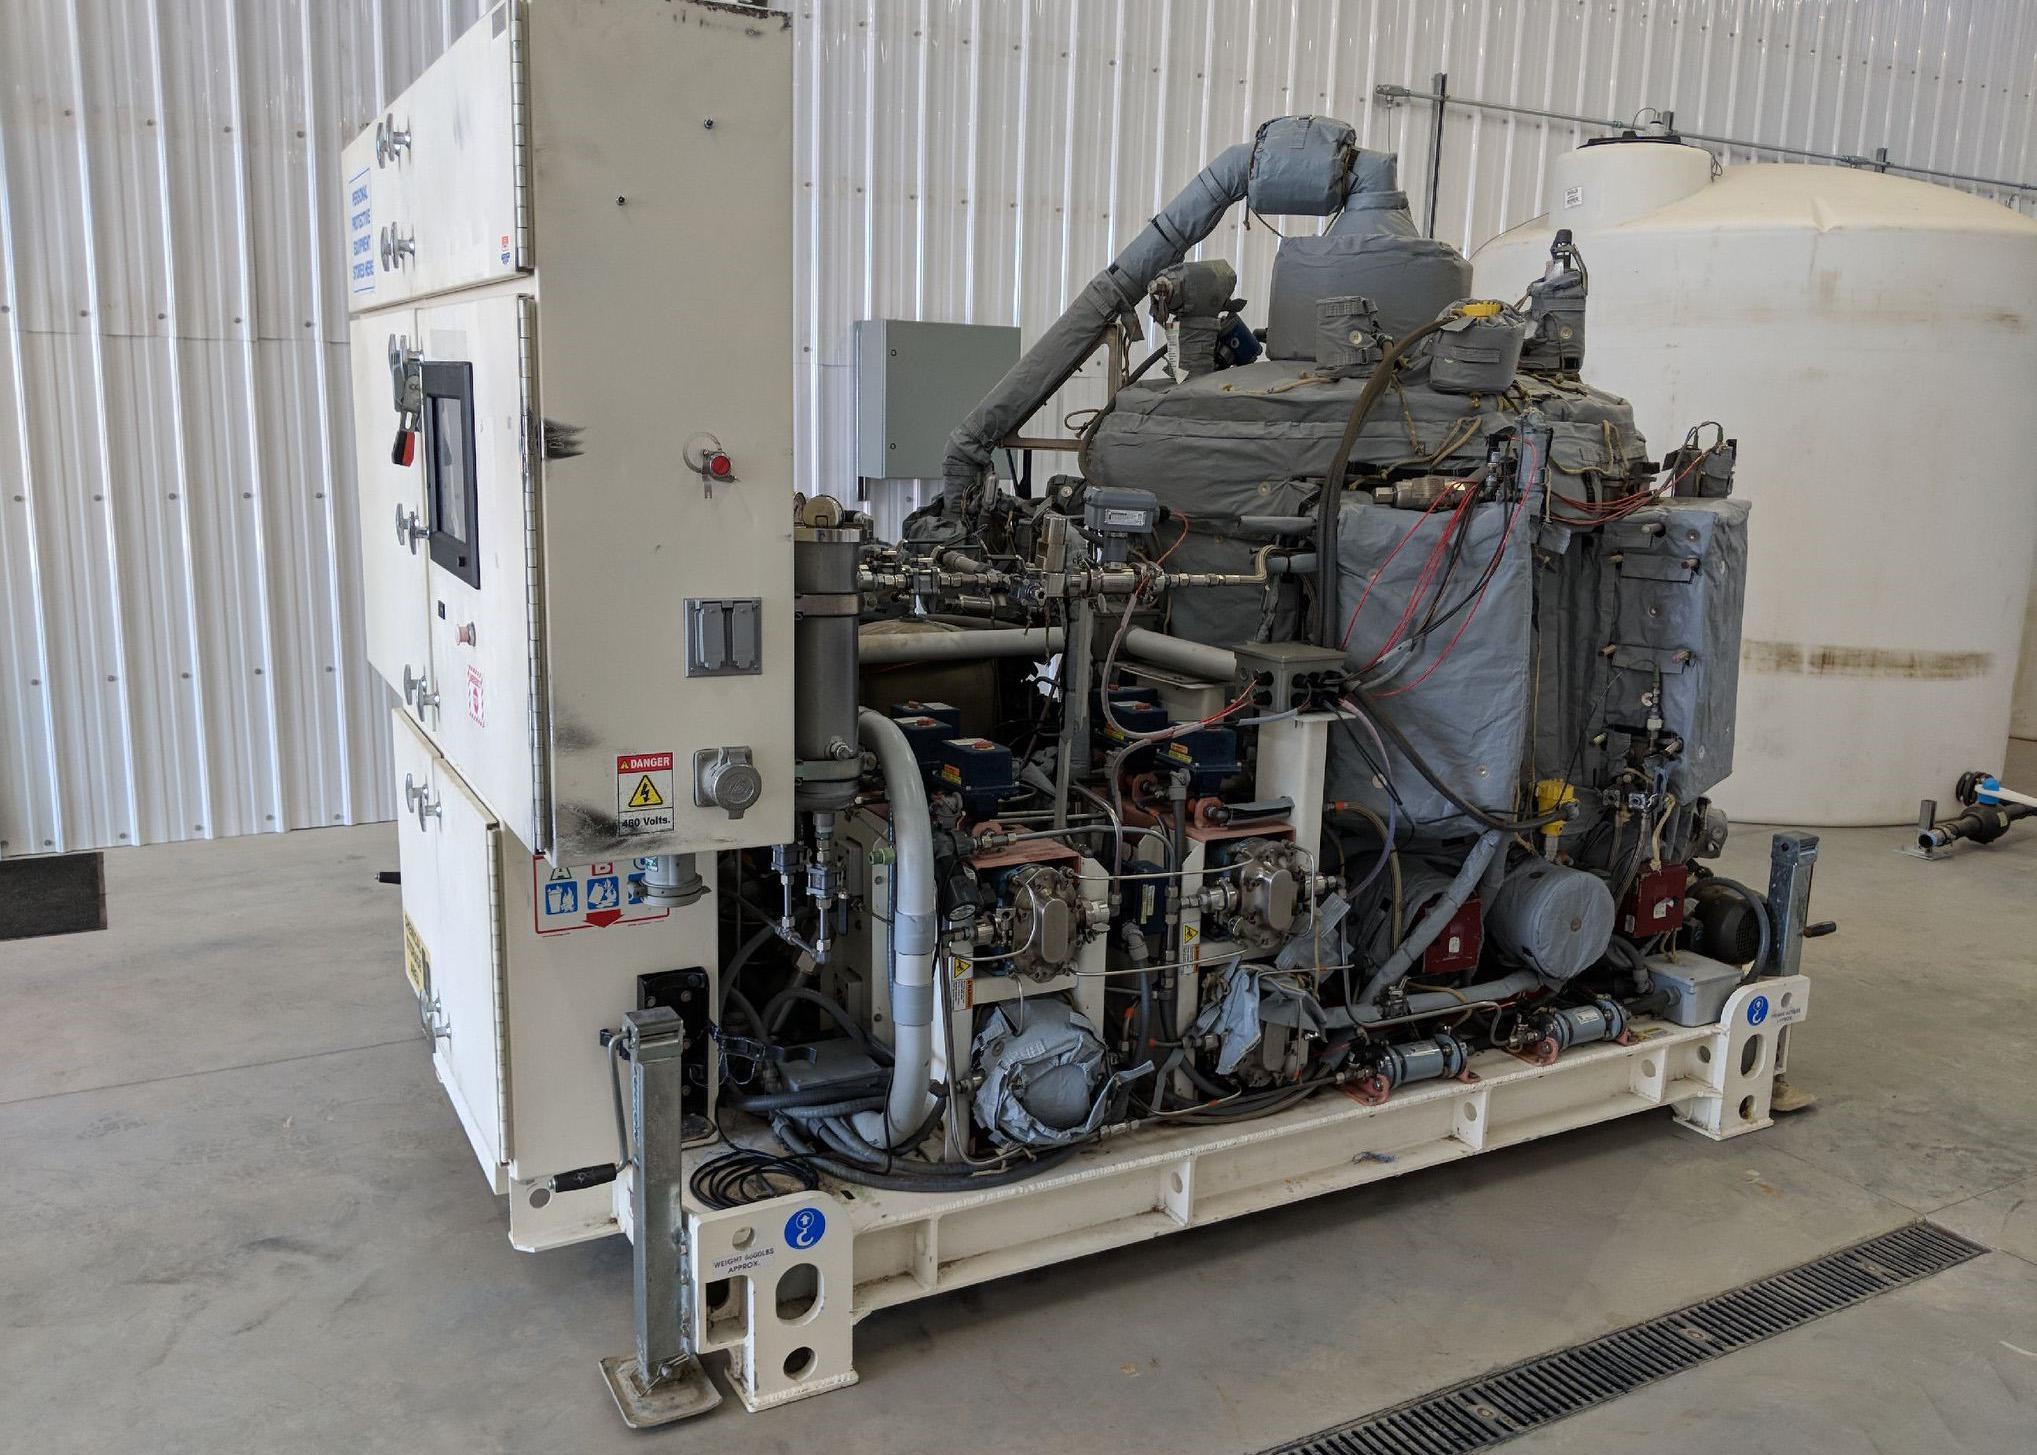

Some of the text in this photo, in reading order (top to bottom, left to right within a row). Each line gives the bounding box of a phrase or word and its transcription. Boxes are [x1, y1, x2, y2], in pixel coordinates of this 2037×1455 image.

[630, 757, 670, 769] DANGER
[643, 816, 671, 826] Volts.
[713, 1255, 742, 1268] WEIGHT
